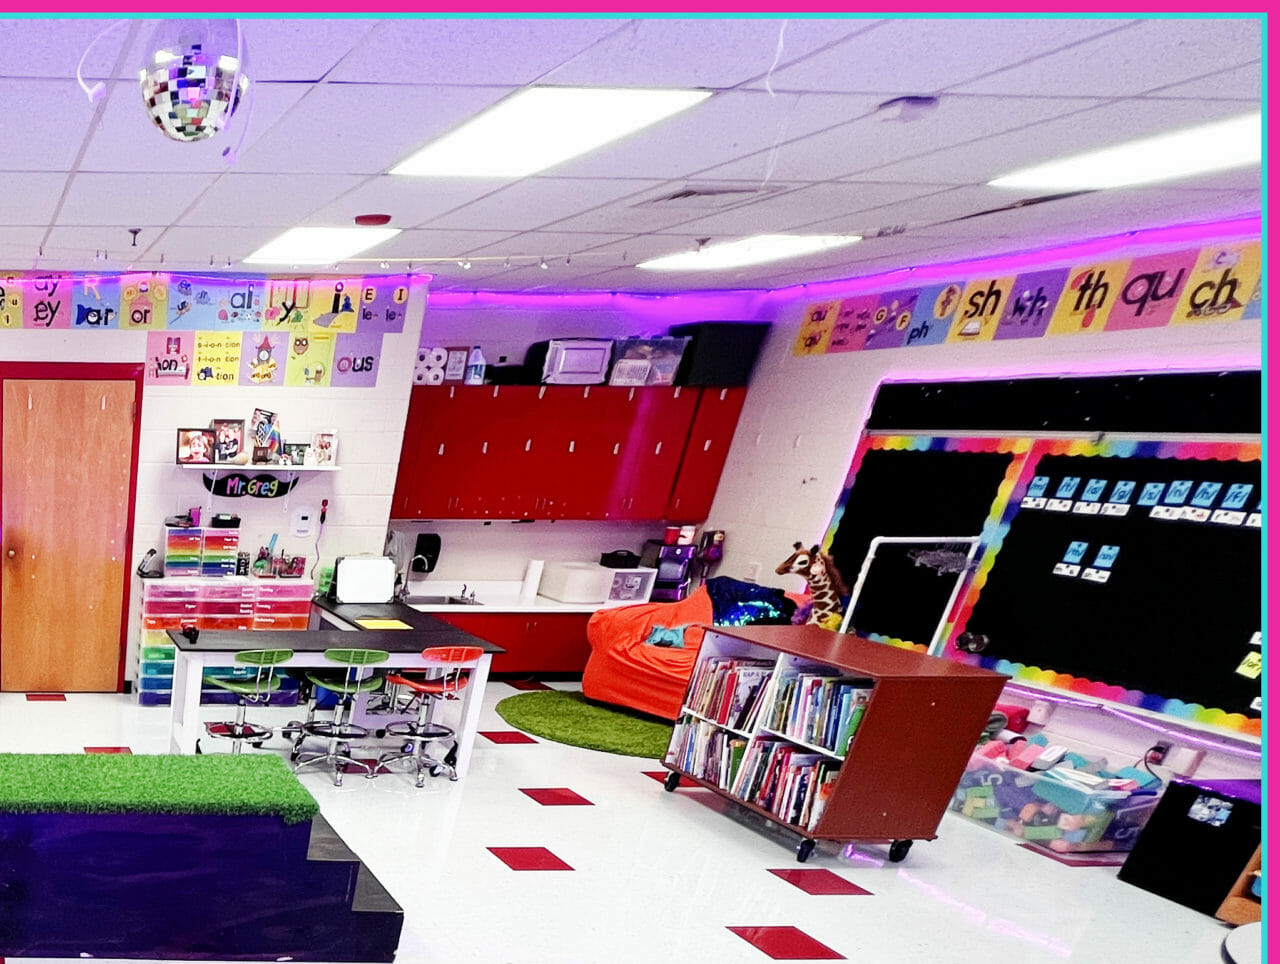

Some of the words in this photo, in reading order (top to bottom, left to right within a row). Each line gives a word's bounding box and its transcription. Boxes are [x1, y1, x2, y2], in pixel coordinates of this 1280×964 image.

[963, 279, 1002, 319] sh
[1073, 269, 1110, 312] th
[1121, 267, 1186, 317] qu
[1189, 267, 1239, 310] ch
[34, 300, 61, 327] ey
[131, 308, 151, 324] or
[906, 320, 930, 345] ph
[336, 356, 374, 374] ous
[226, 476, 246, 495] Mr.
[247, 479, 279, 497] Greg
